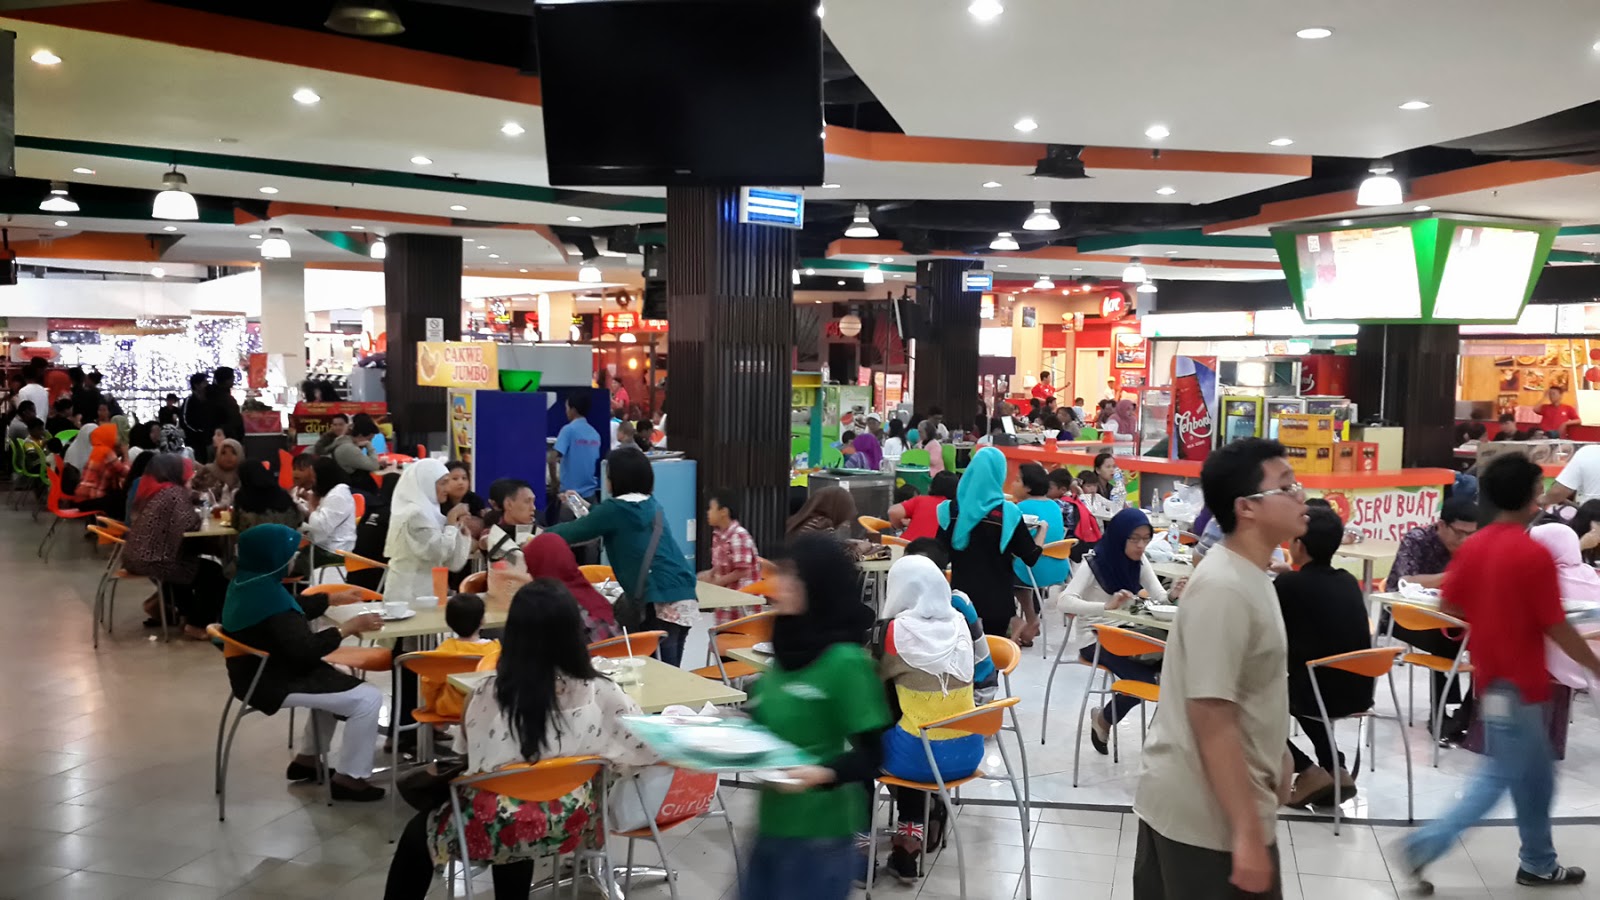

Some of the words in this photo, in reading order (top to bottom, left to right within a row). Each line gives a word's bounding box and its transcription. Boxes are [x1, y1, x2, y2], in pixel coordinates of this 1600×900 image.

[444, 347, 482, 363] CAKWE
[452, 365, 488, 381] JUMBO
[1353, 494, 1392, 526] SERU
[1396, 490, 1438, 519] BUAT
